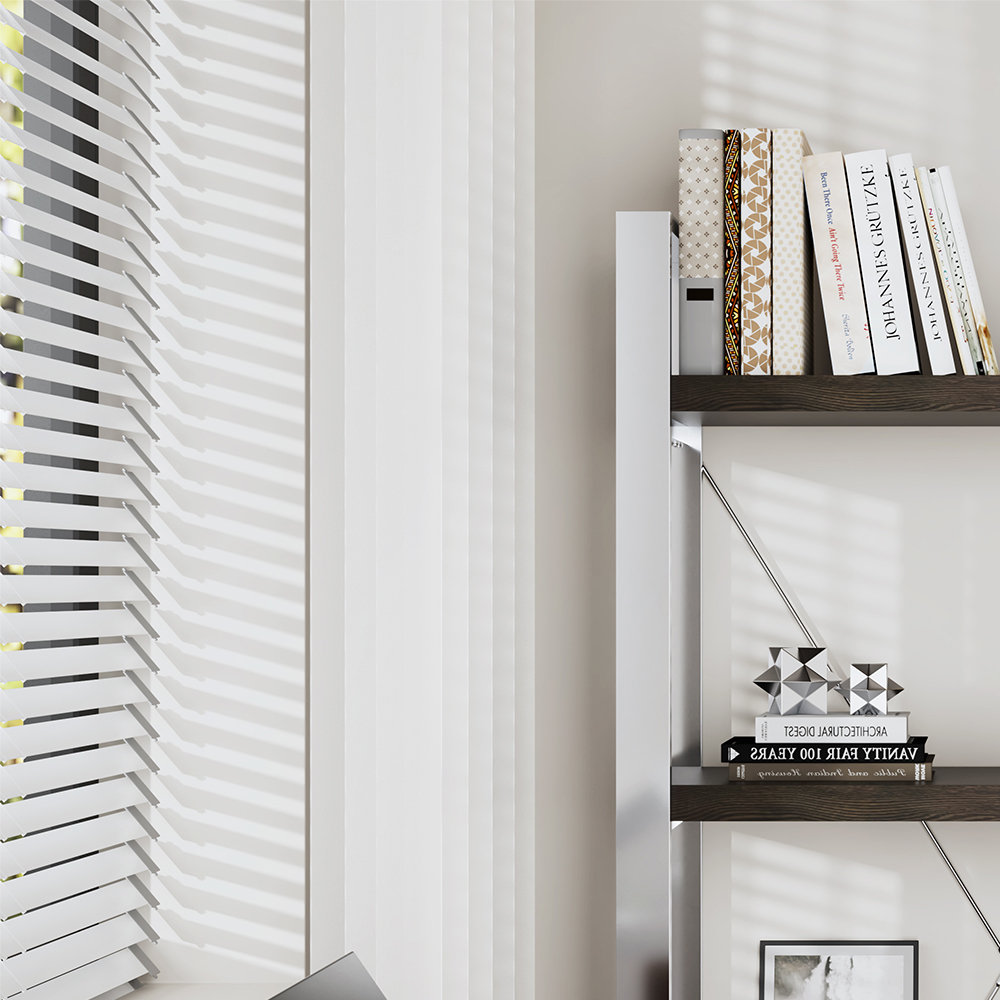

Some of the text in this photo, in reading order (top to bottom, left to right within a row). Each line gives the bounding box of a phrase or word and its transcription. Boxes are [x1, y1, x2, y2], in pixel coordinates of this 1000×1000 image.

[820, 171, 846, 301] Been There Once Ain't Going There Twice
[860, 163, 901, 341] JOHANNES GRÜTZKE
